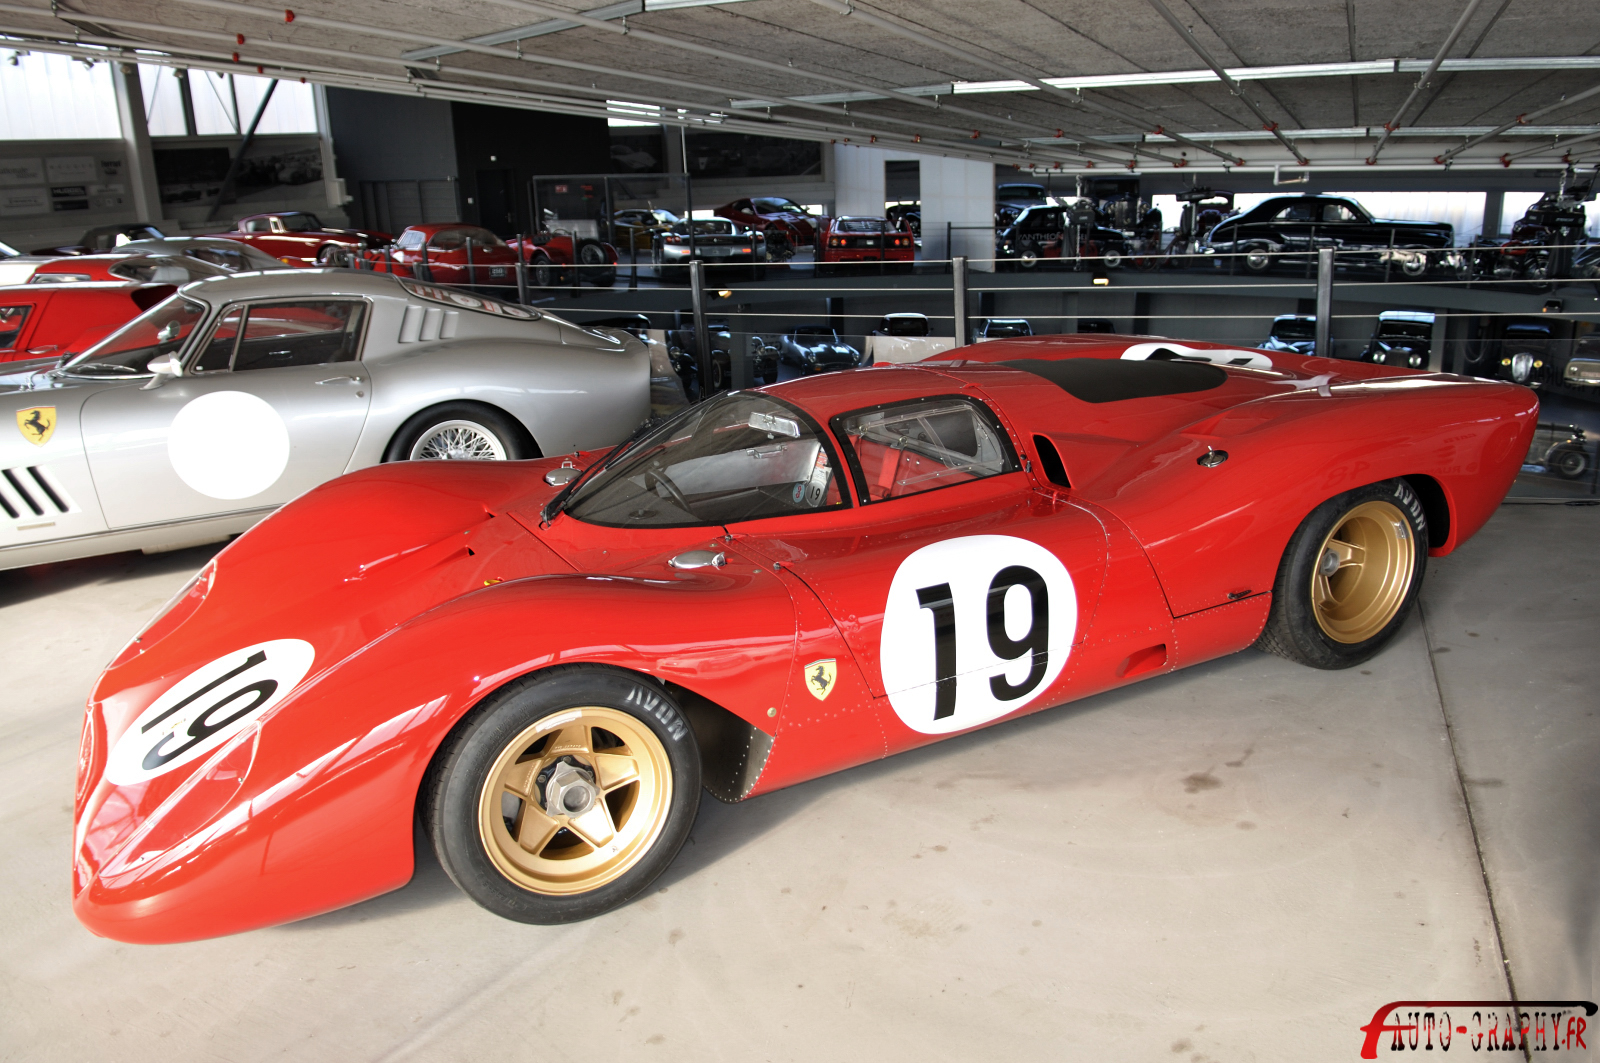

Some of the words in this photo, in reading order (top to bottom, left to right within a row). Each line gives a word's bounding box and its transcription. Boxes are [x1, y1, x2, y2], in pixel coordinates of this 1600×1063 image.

[810, 486, 821, 501] 19
[1394, 484, 1426, 531] AVON
[915, 565, 1049, 721] 19
[141, 650, 278, 771] 19
[625, 686, 689, 741] AVON
